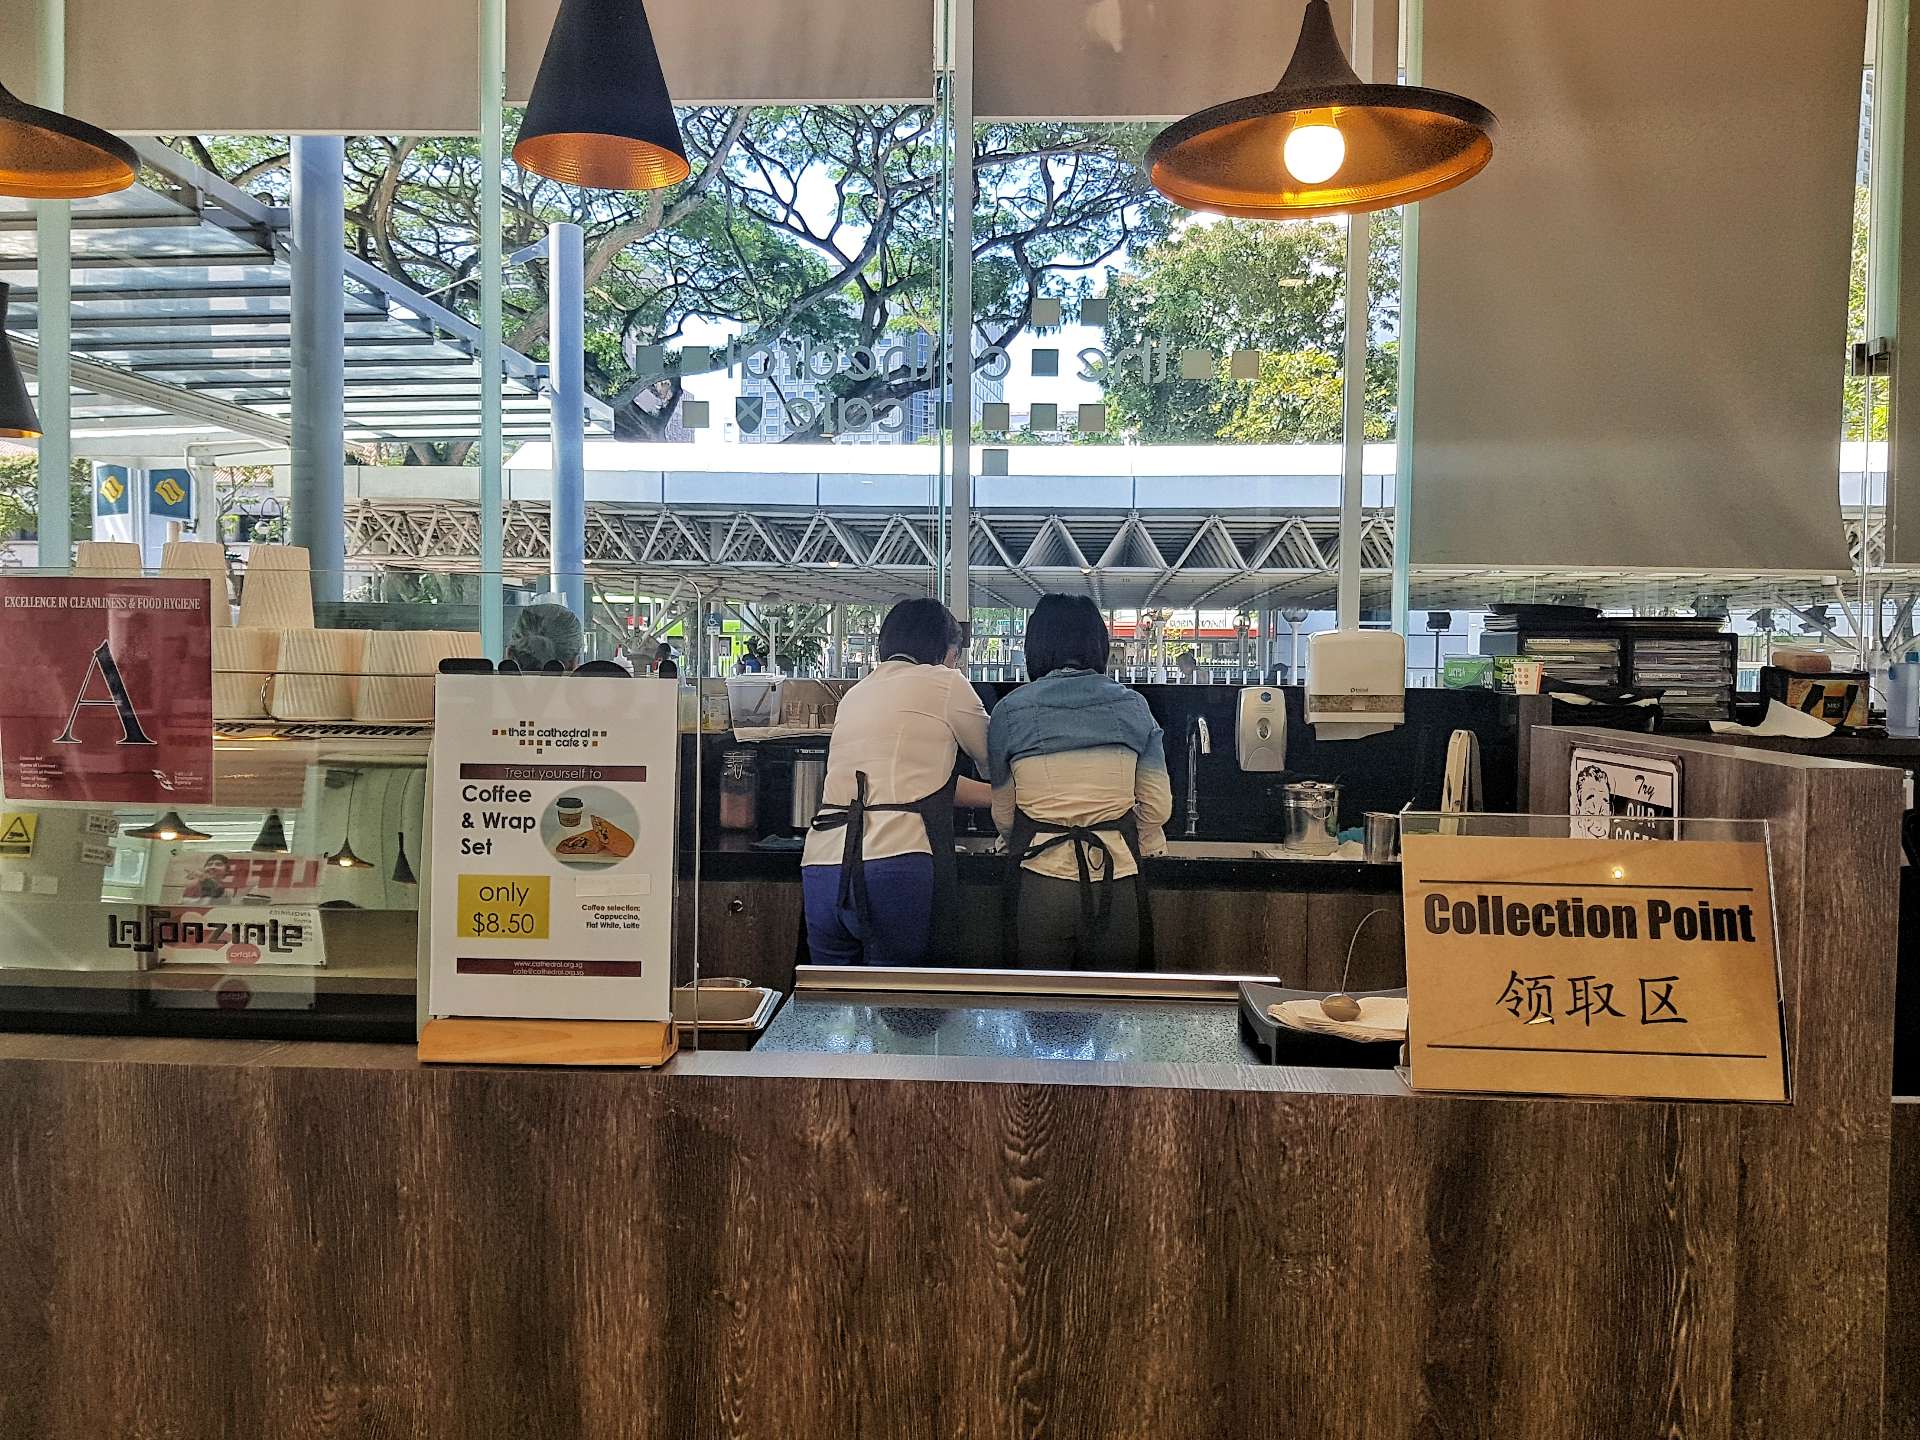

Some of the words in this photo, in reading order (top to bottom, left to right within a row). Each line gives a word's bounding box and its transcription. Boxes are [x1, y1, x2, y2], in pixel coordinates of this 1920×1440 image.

[4, 596, 57, 608] EXCELLENCE
[58, 597, 68, 608] IN
[69, 597, 127, 609] CLEANLINESS
[128, 598, 136, 609] &
[137, 598, 162, 610] FOOD
[163, 598, 201, 610] HYGIENE
[52, 639, 158, 745] A
[508, 727, 526, 737] the
[536, 728, 590, 738] cathedral
[555, 738, 580, 748] cafe
[504, 767, 536, 779] Treat
[538, 768, 586, 781] yourself
[588, 769, 602, 780] to
[462, 784, 533, 803] Coffee
[1634, 774, 1655, 801] Try
[461, 812, 475, 829] &
[482, 811, 536, 833] Wrap
[1626, 802, 1656, 829] OUR
[460, 837, 493, 855] Set
[479, 881, 530, 907] only
[581, 904, 605, 912] Coffee
[607, 904, 641, 912] selection:
[594, 912, 641, 921] Cappuccino,
[472, 911, 534, 936] $8.50
[585, 921, 599, 929] Flat
[600, 921, 622, 930] White,
[623, 921, 640, 929] Latte
[1423, 893, 1638, 939] Collection
[1646, 899, 1756, 943] Point
[1496, 969, 1688, 1026] 领取区
